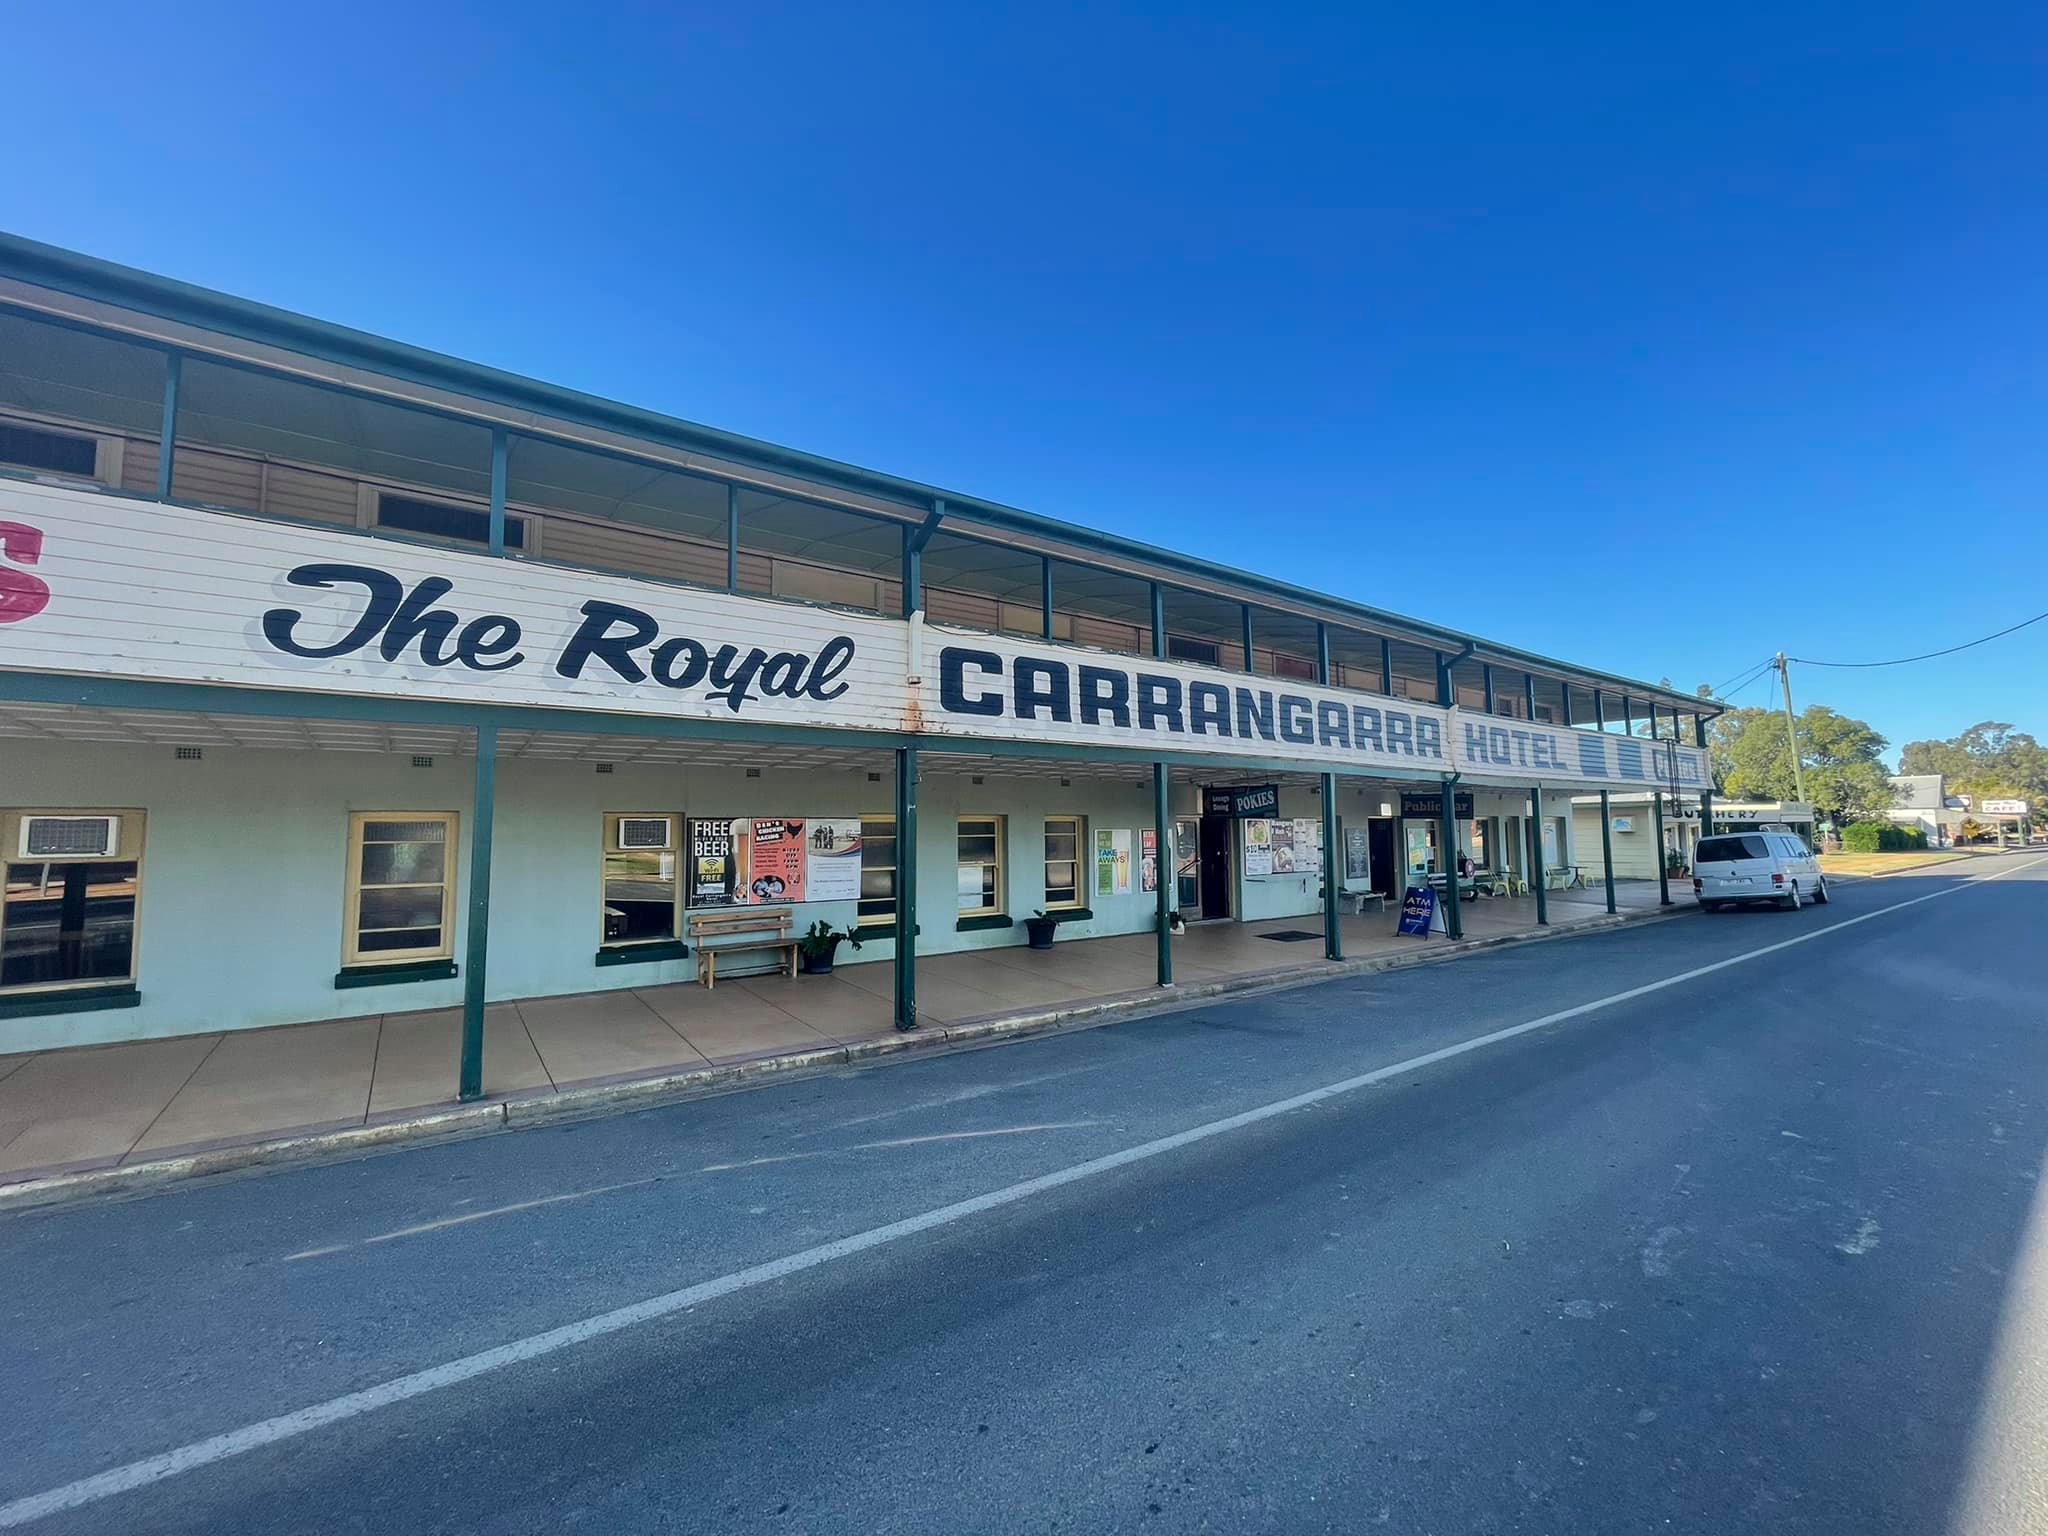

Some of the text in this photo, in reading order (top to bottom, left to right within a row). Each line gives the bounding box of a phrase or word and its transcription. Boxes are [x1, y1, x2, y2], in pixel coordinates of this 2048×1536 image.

[262, 563, 855, 712] The Royal
[939, 647, 1442, 759] CARRANGARRA
[1465, 723, 1568, 770] HOTEL
[1236, 790, 1275, 812] POKIES
[1404, 801, 1468, 812] Public ar
[1674, 809, 1759, 819] UTHERY
[695, 821, 729, 836] FREE
[695, 841, 729, 857] BEER
[1098, 849, 1117, 857] TAKE
[701, 874, 722, 882] FREE
[1406, 897, 1431, 906] ATM
[1403, 907, 1431, 917] HERE
